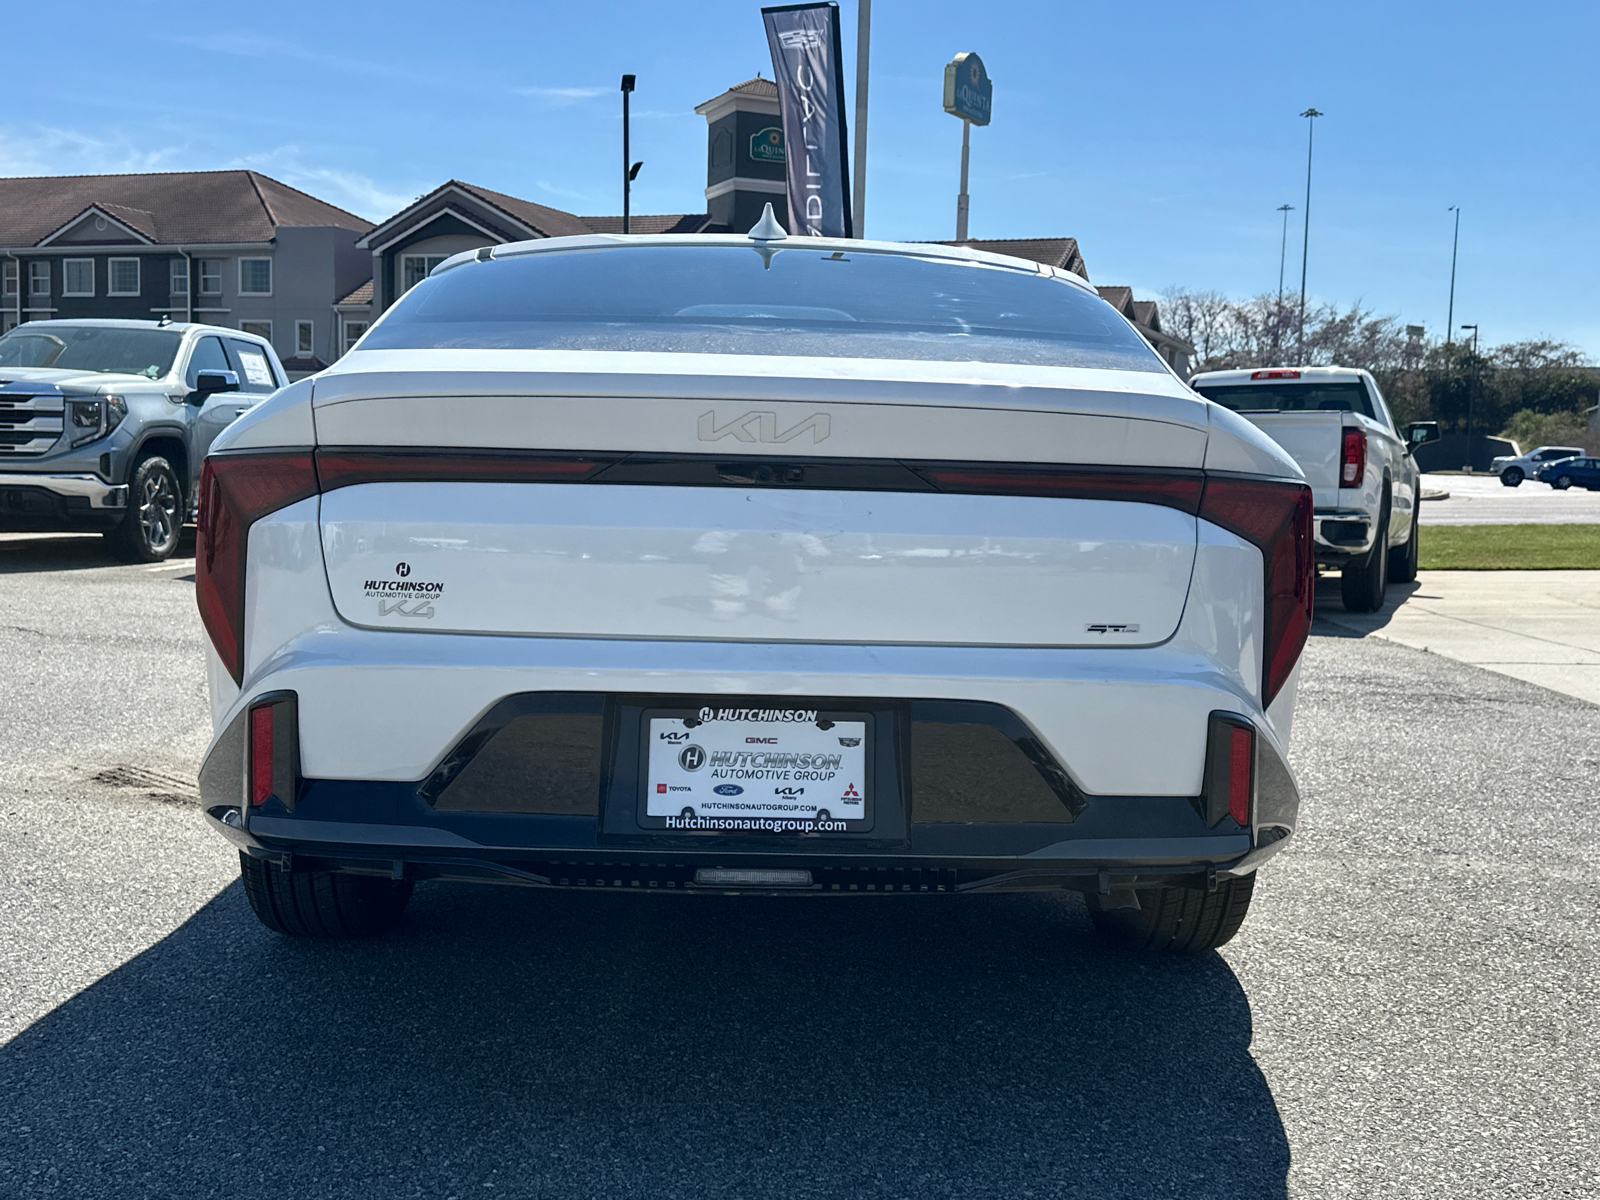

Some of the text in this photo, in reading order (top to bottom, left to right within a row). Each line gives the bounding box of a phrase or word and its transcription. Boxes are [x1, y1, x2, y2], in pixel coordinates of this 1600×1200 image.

[760, 144, 785, 156] QUIN
[698, 410, 831, 444] KIA
[364, 580, 444, 592] HUTCHINSON
[365, 591, 441, 600] AUTOMOTIVE GROUP
[378, 599, 434, 619] K4
[717, 709, 818, 723] HUTCHINSON
[660, 732, 690, 740] KIA
[709, 751, 842, 770] HUTCHINSON
[711, 769, 835, 781] AUTOMOTIVE GROUP
[717, 785, 740, 795] Ford
[775, 787, 804, 795] KIA
[701, 803, 818, 812] HUTCHINSONAUTOGROUP.COM
[665, 816, 847, 833] Hutchinsonautogroup.com
